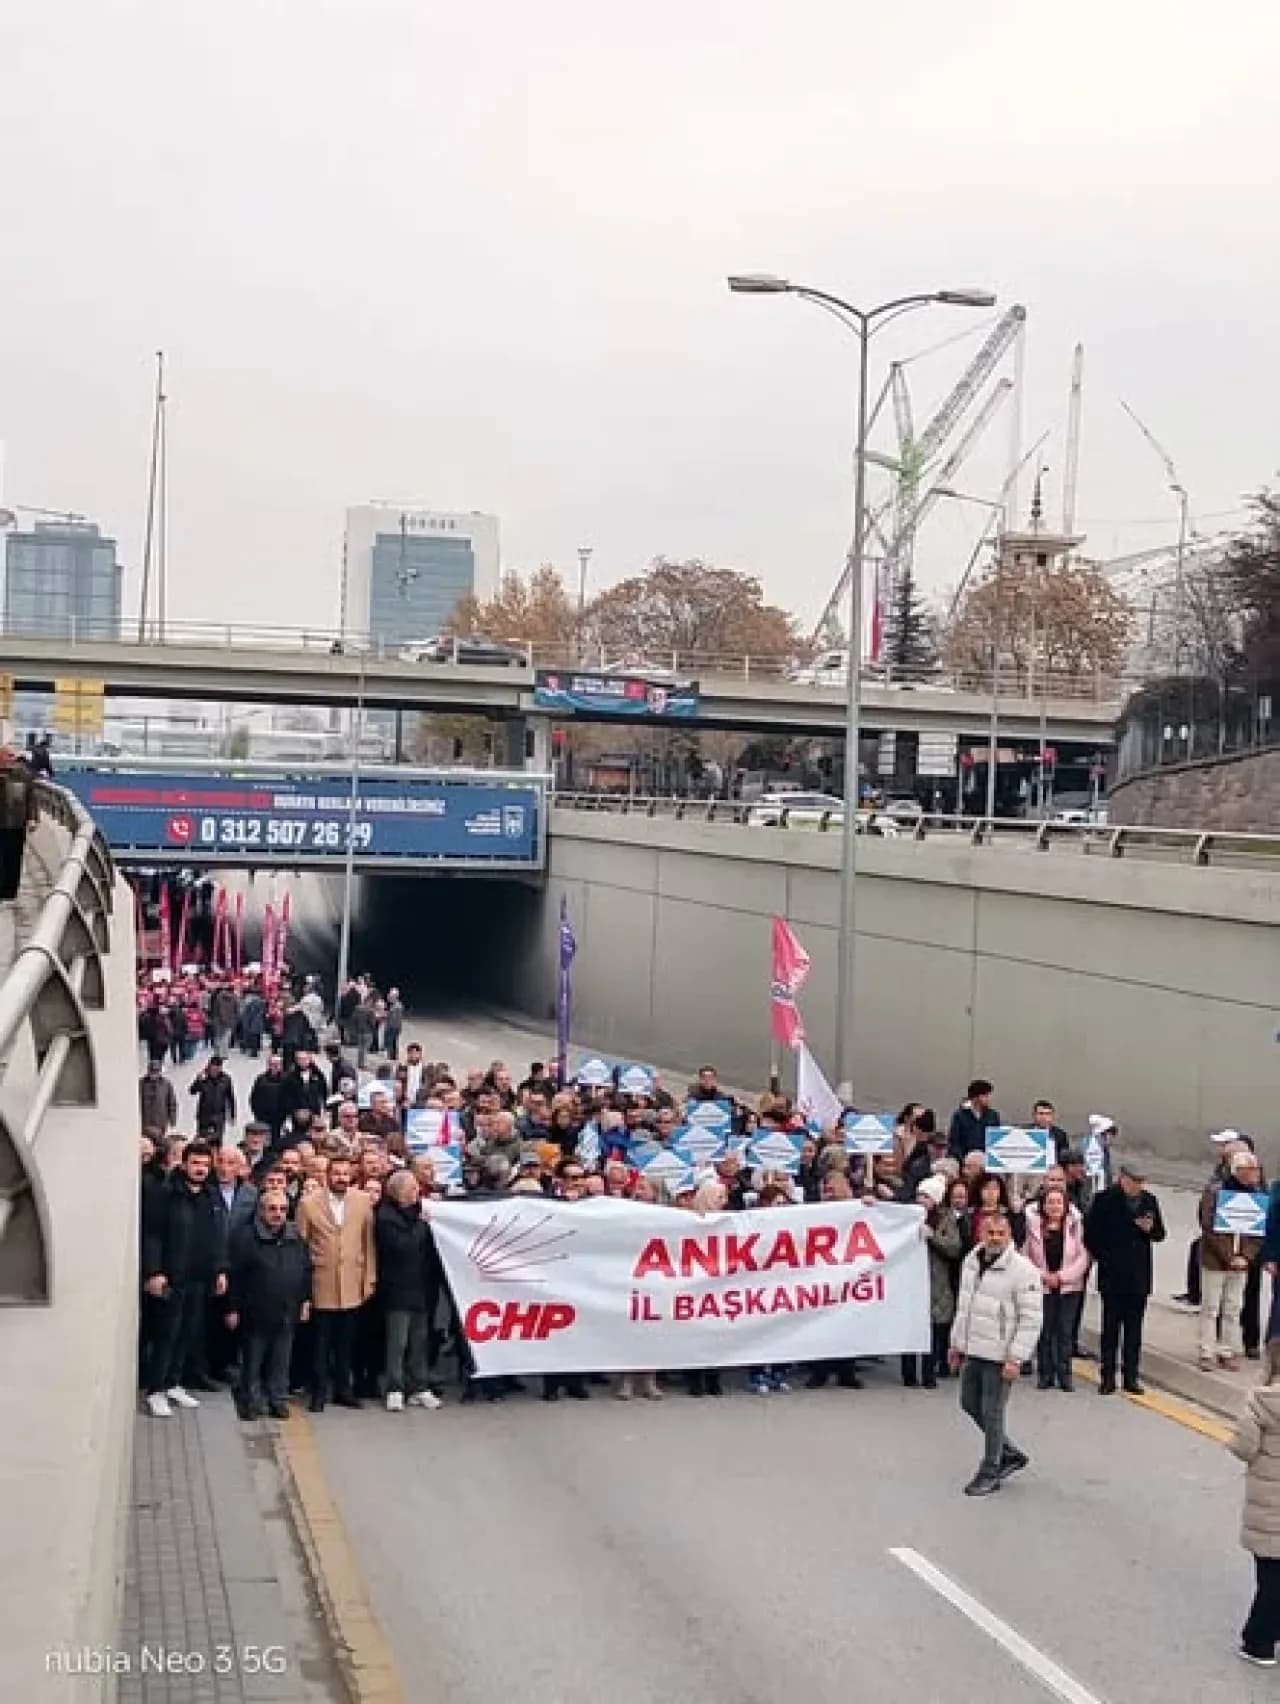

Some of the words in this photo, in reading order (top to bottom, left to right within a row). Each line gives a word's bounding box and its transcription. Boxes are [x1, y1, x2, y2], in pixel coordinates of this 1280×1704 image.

[201, 817, 215, 842] 0
[221, 819, 261, 844] 312
[268, 820, 307, 844] 507
[312, 822, 339, 844] 26
[632, 1220, 885, 1278] ANKARA
[629, 1287, 662, 1321] İL
[673, 1270, 885, 1322] BAŞKANLIĞI
[464, 1301, 576, 1343] CHP
